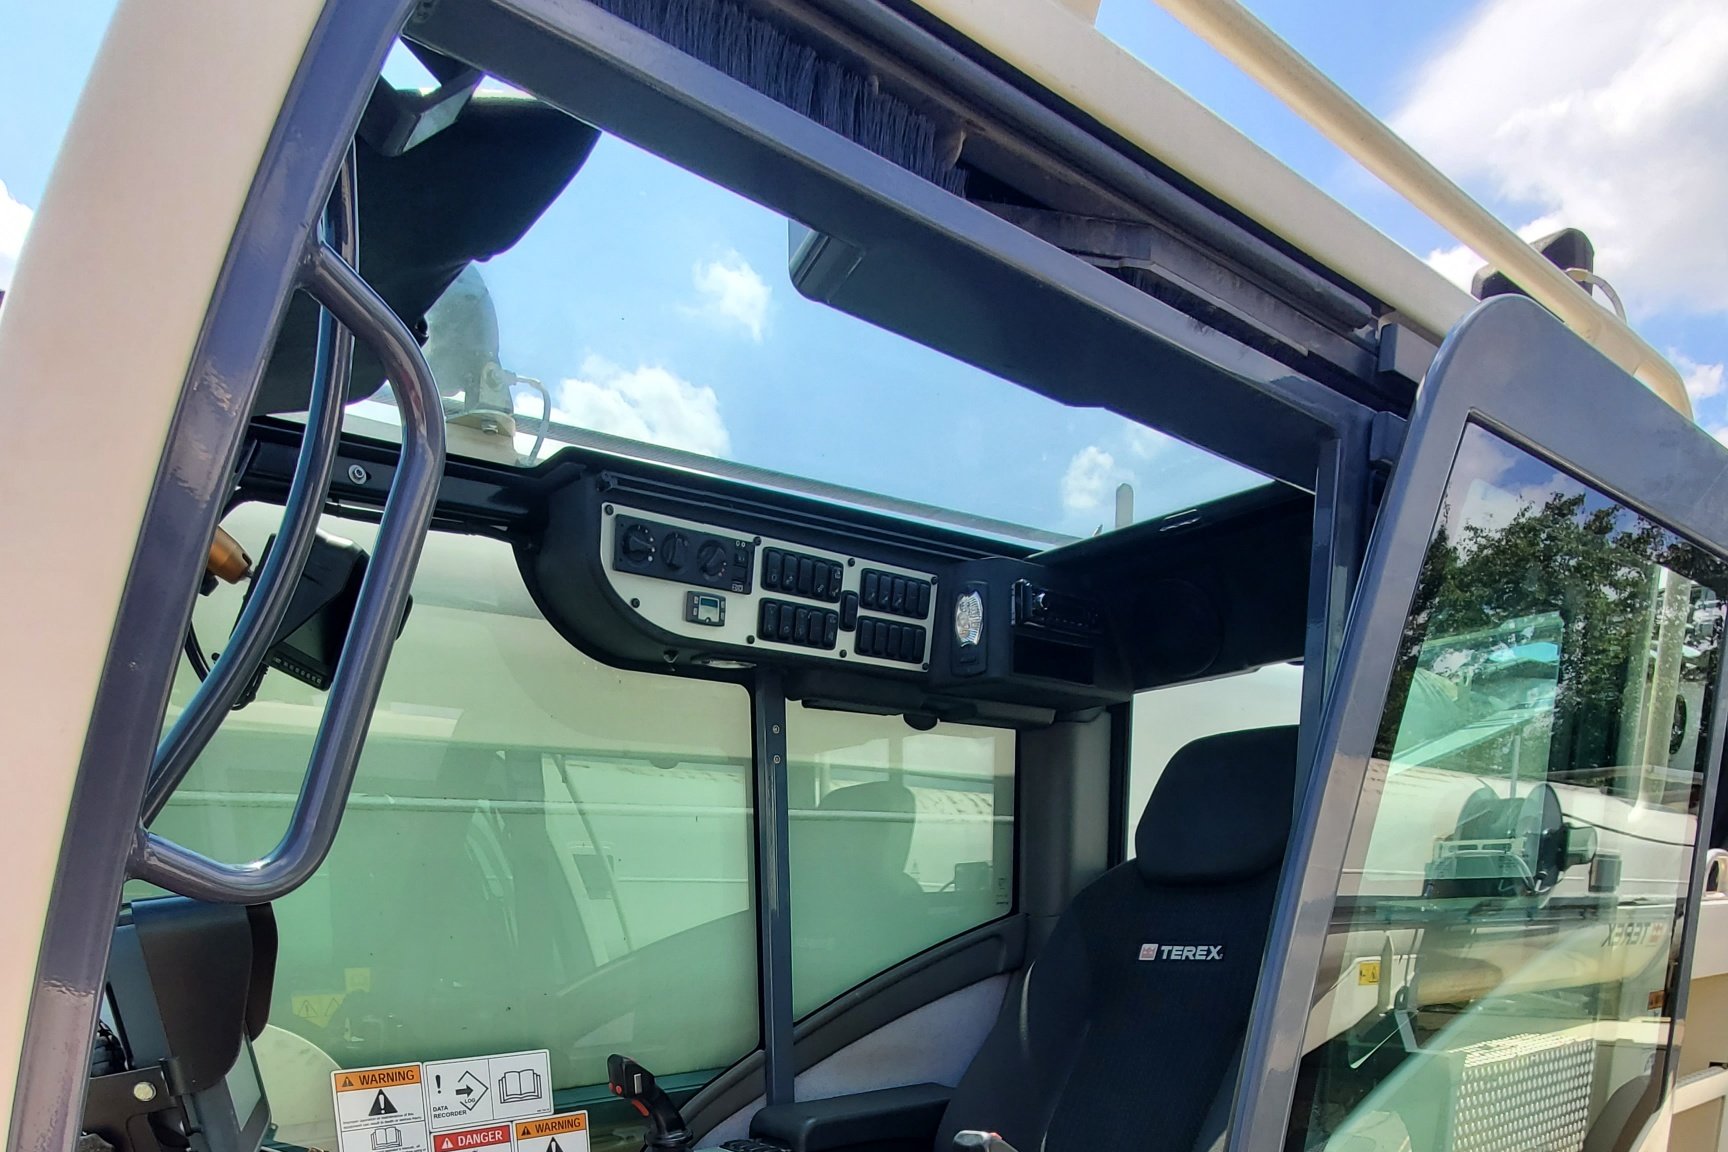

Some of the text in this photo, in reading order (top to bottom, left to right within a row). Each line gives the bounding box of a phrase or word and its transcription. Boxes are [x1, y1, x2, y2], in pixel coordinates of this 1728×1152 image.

[1160, 945, 1222, 960] TEREX
[358, 1069, 415, 1086] WARNING
[433, 1109, 467, 1119] RECORDER
[535, 1117, 581, 1134] WARNING
[457, 1130, 503, 1147] DANGER
